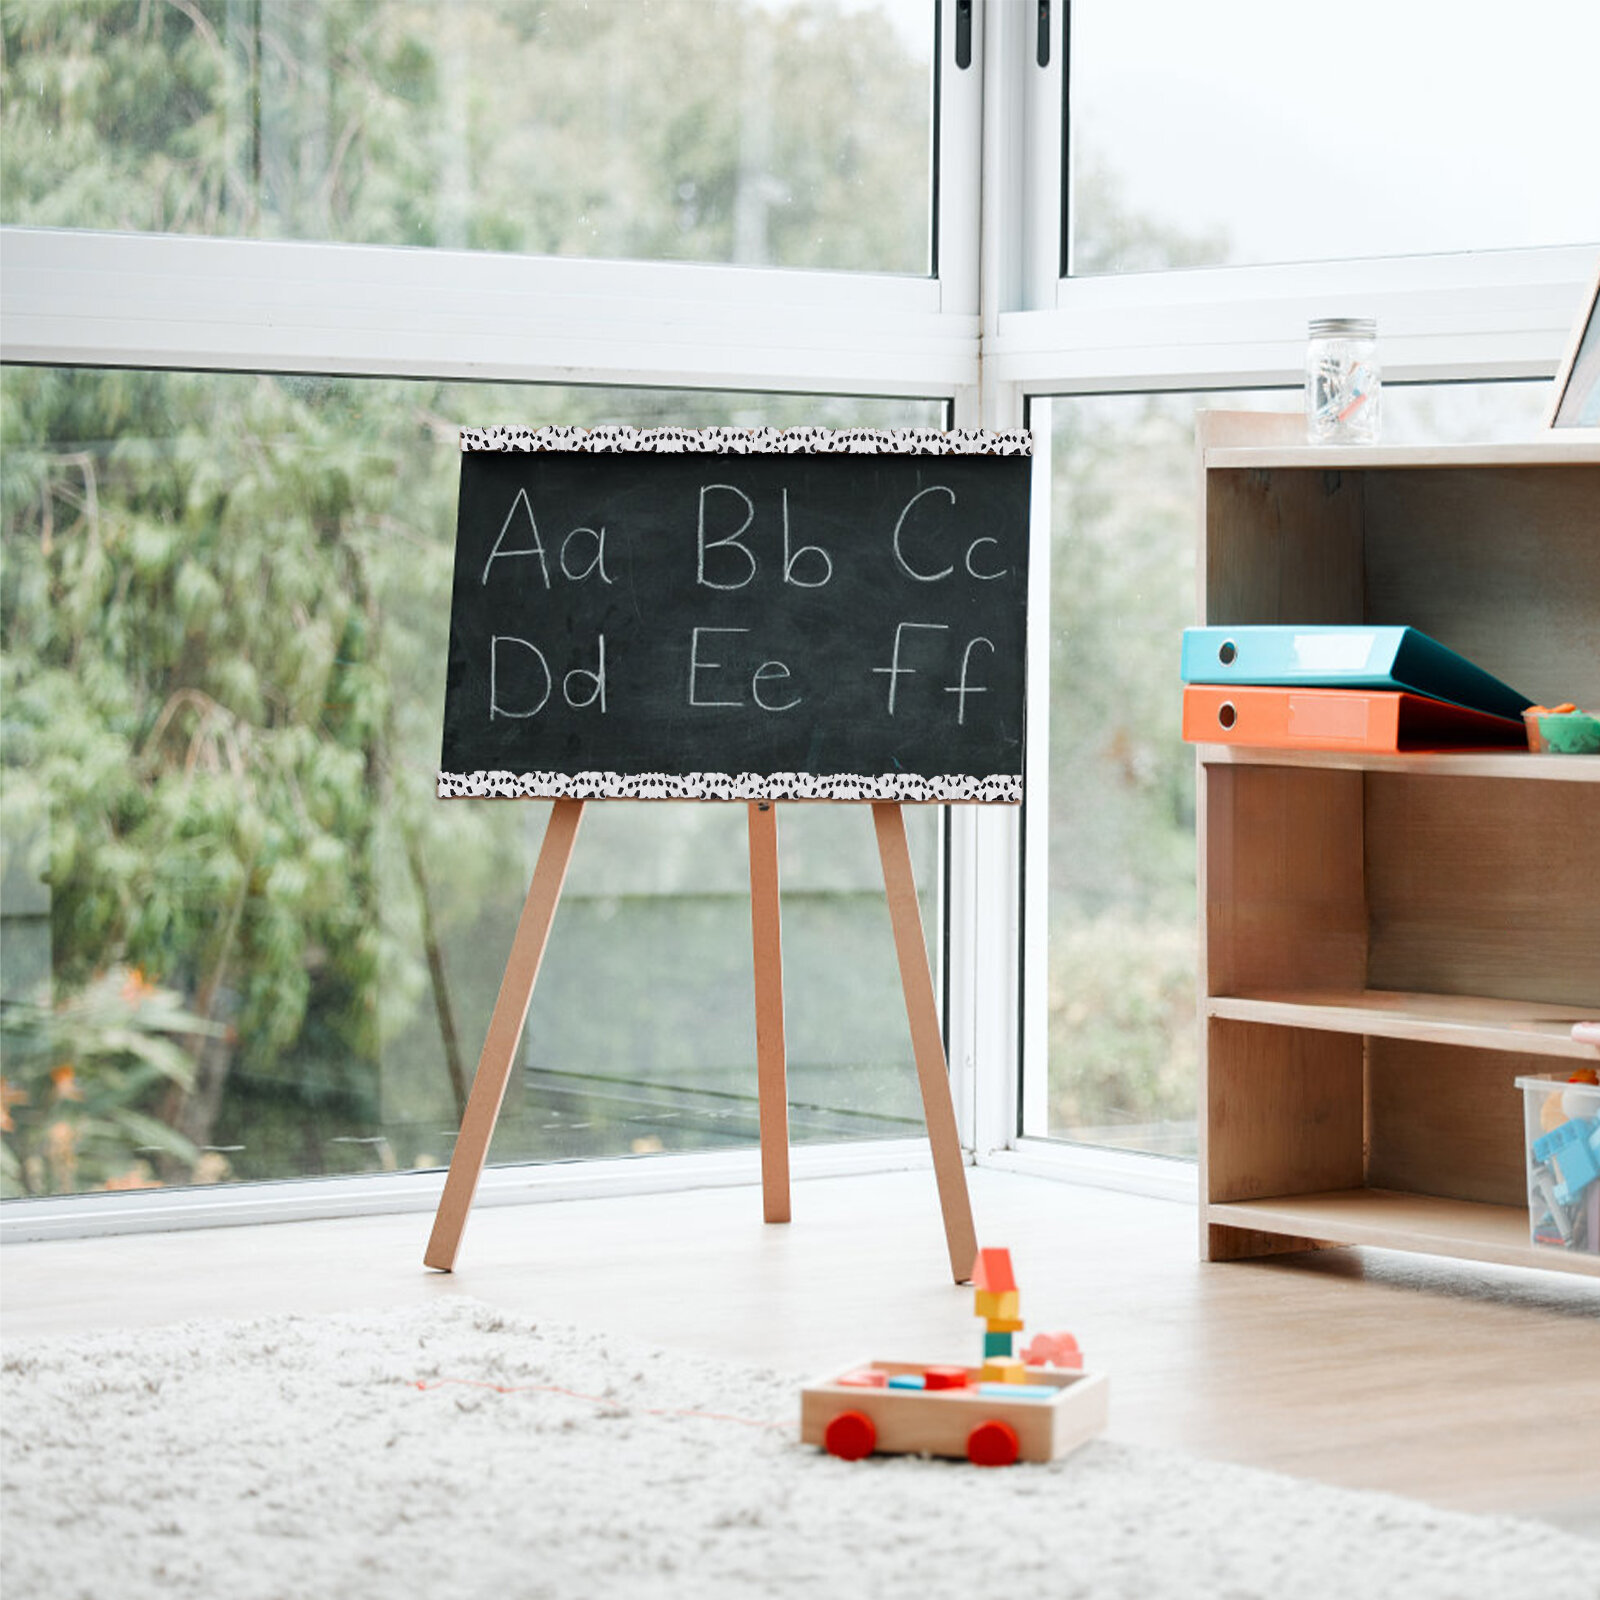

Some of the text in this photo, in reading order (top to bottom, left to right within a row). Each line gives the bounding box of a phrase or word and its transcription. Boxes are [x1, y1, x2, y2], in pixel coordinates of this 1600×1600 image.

[482, 484, 1007, 590] Aa Bb Cc
[489, 622, 995, 725] Dd Ee Ff
